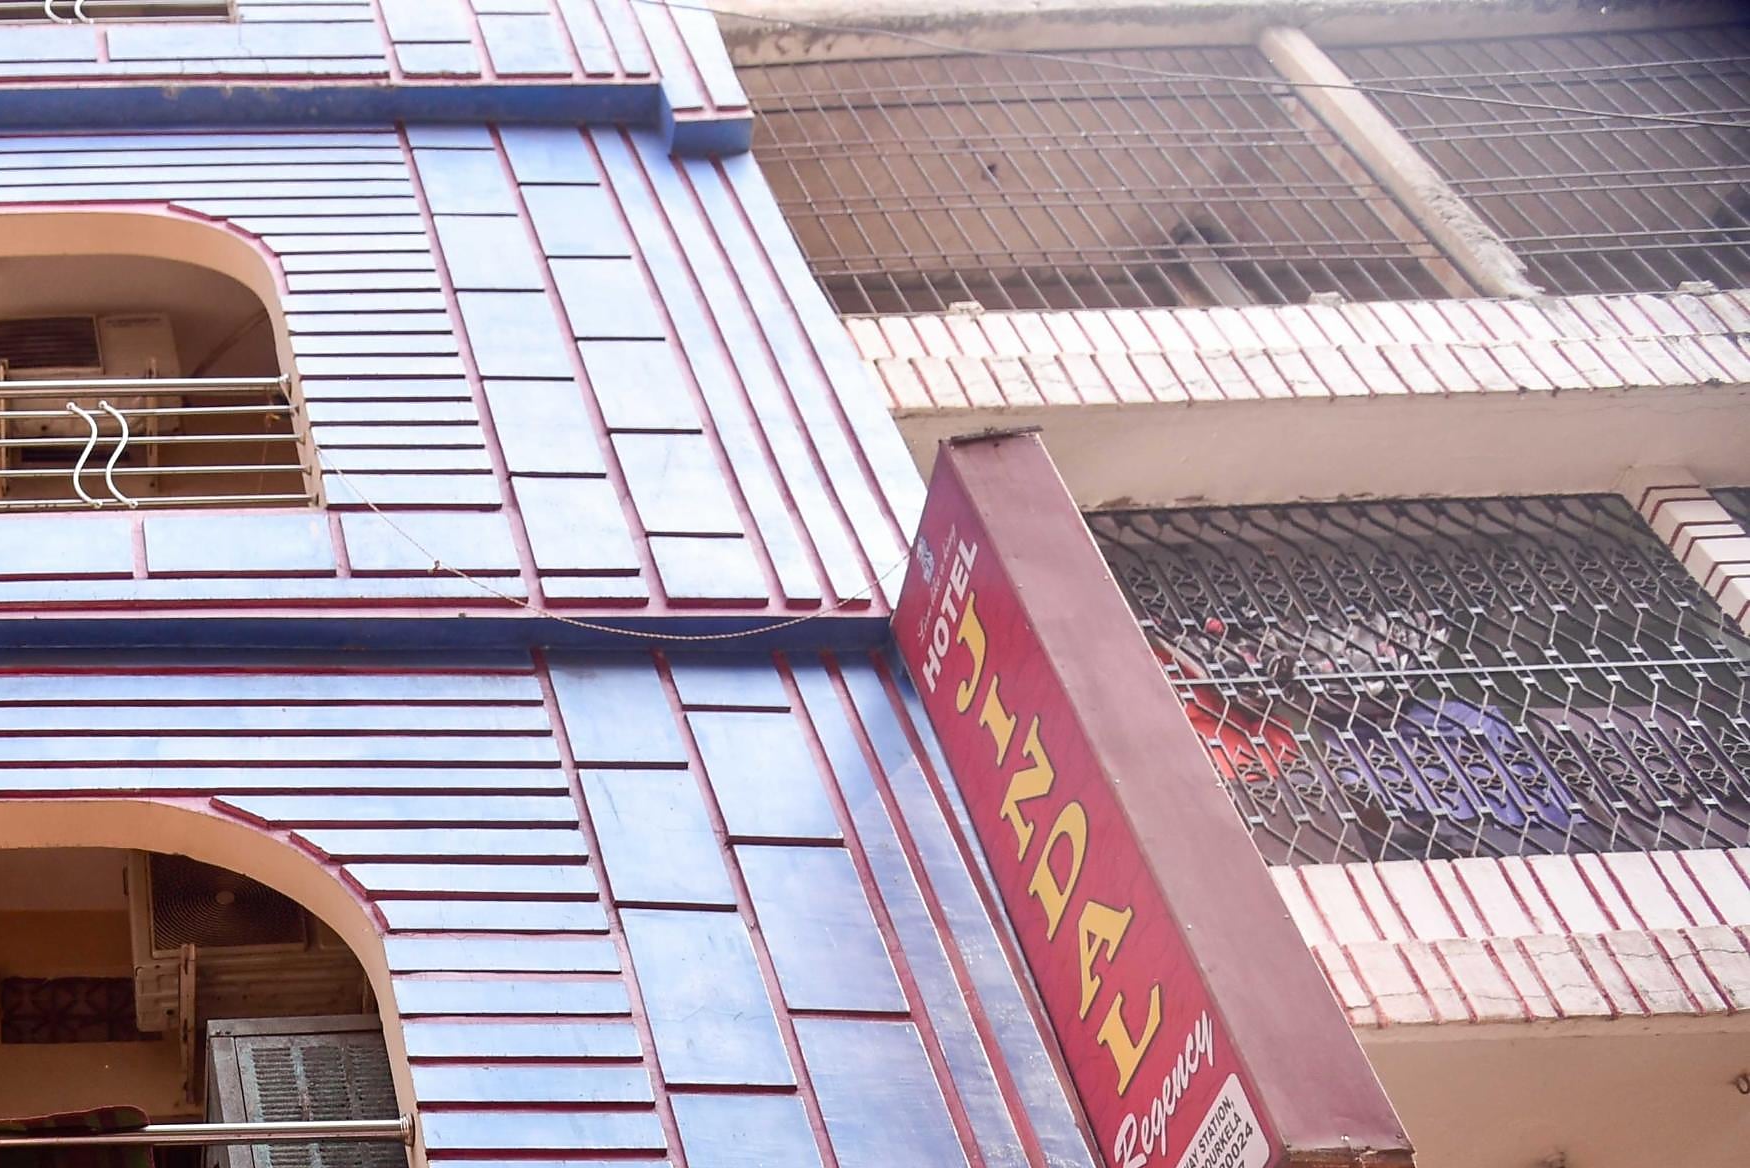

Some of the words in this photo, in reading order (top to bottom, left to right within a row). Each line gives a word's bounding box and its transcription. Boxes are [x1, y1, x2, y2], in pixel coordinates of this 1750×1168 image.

[922, 539, 978, 694] HOTEL
[956, 592, 1161, 1096] JINDAL
[1199, 1096, 1235, 1153] STATION,
